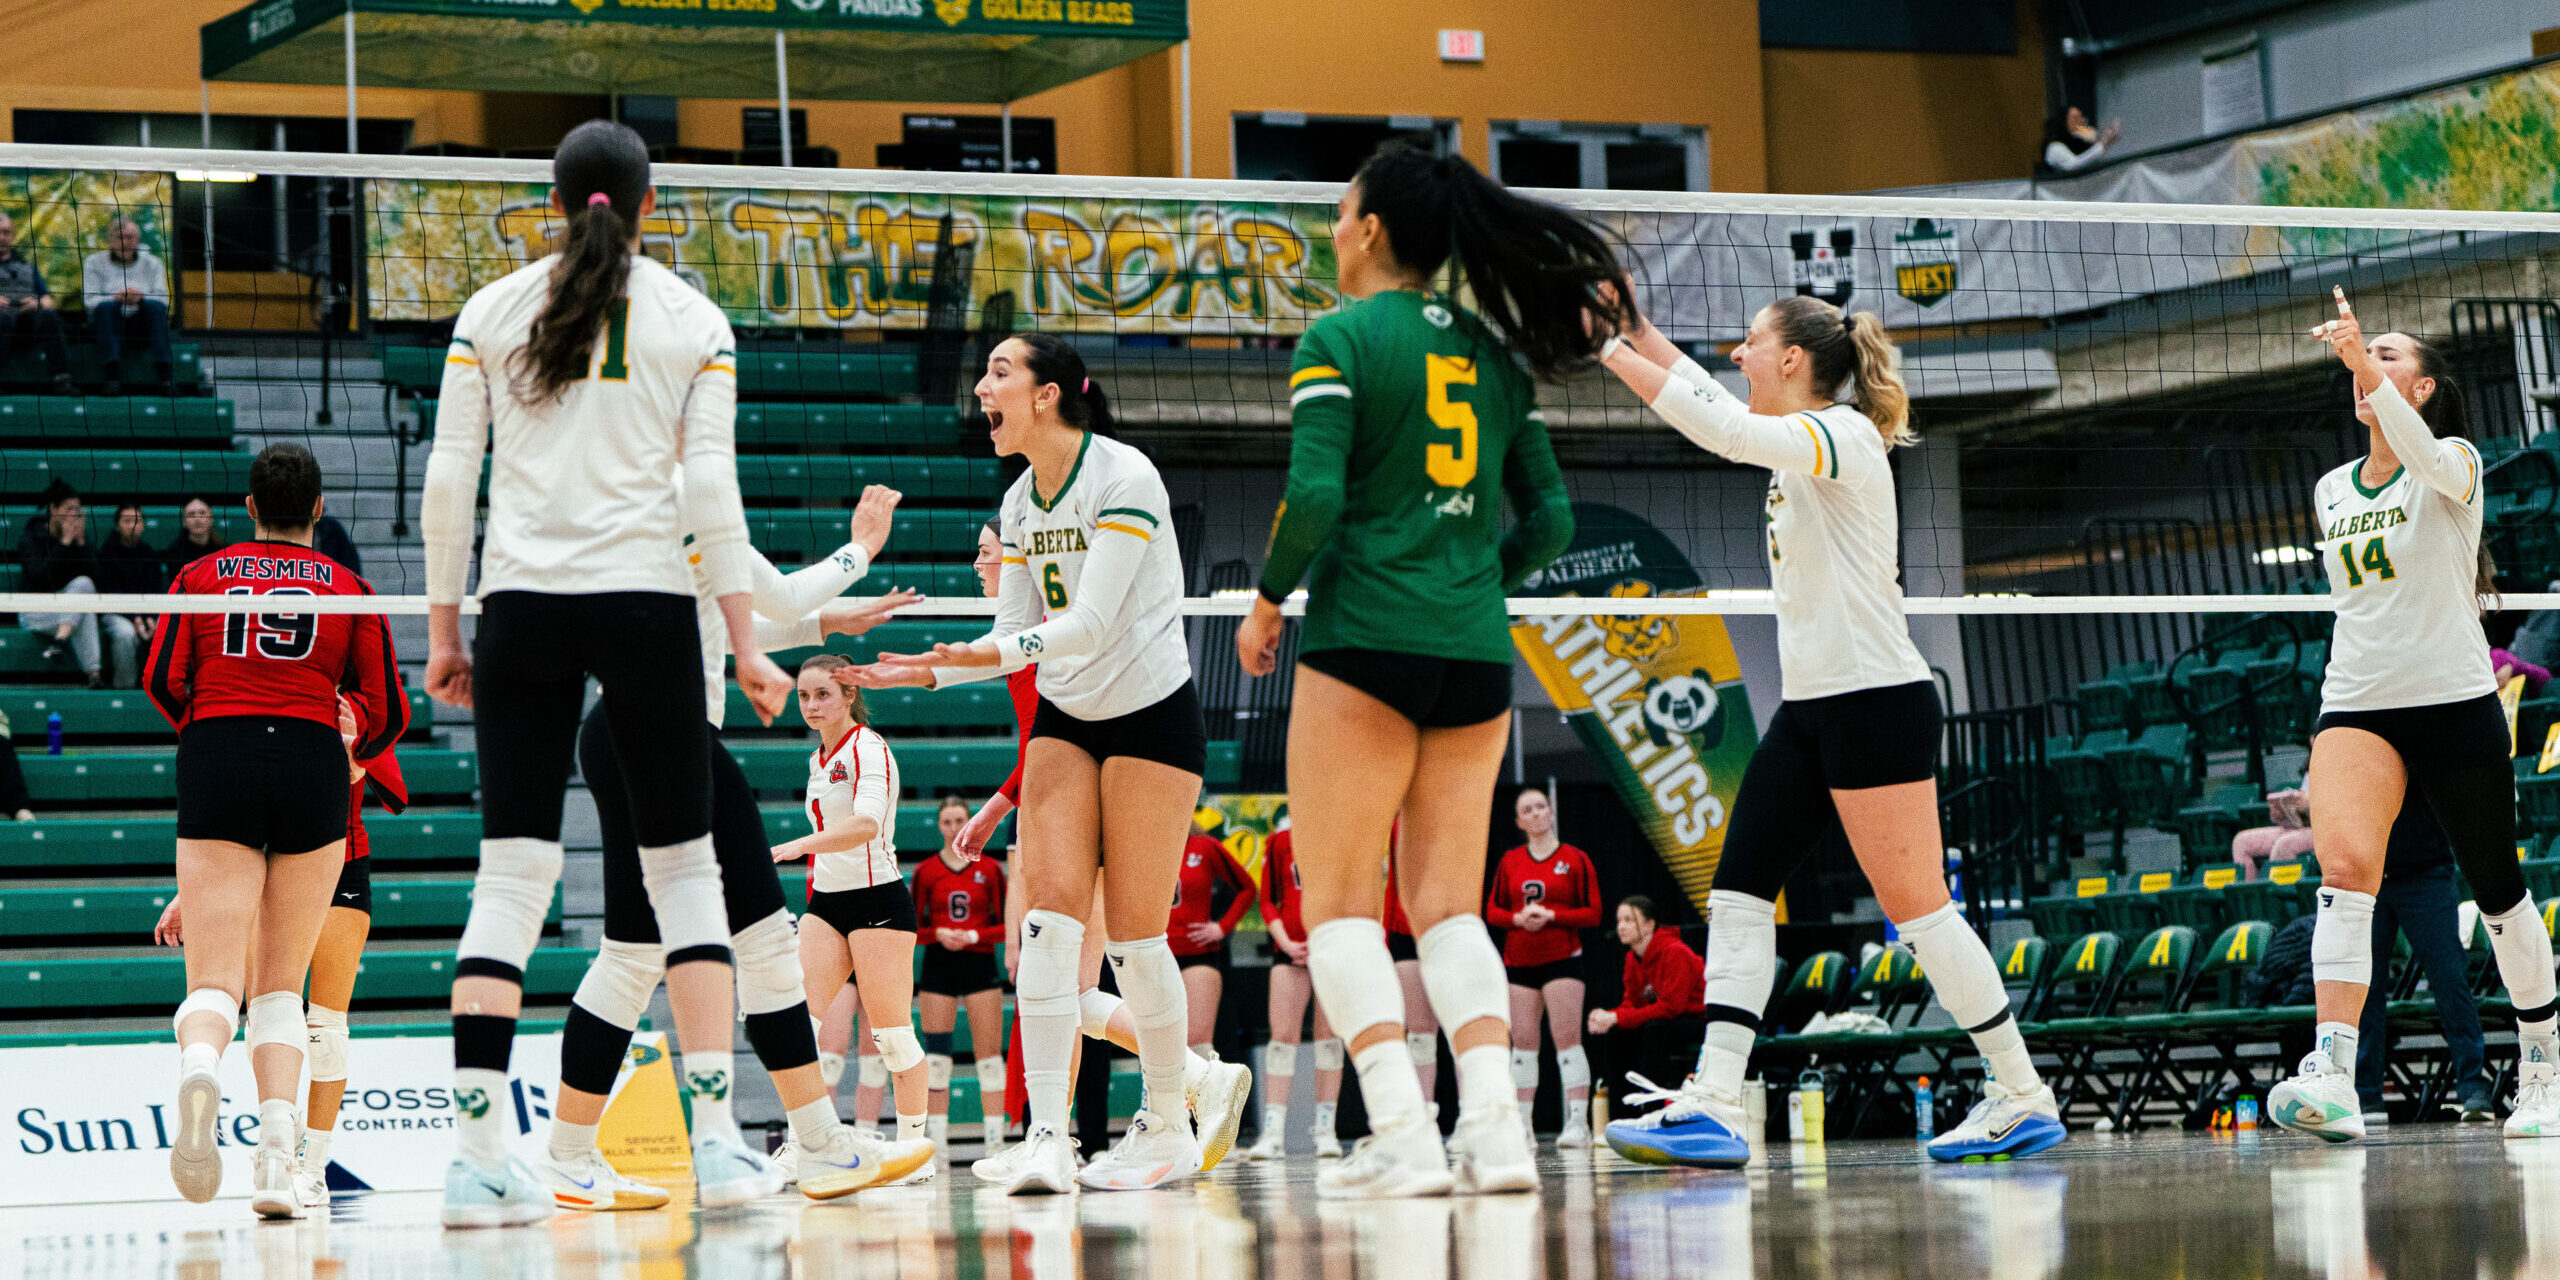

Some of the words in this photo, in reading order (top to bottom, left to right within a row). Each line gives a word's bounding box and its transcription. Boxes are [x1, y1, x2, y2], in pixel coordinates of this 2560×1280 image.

[981, 0, 1063, 21] GOLDEN
[1067, 1, 1135, 25] BEARS
[1021, 206, 1339, 318] ROAR
[1898, 265, 1954, 296] WEST
[1426, 353, 1478, 488] 5
[2327, 506, 2408, 541] ALBERTA
[1025, 527, 1089, 557] BERTA
[216, 556, 332, 586] WESMEN
[1545, 552, 1642, 585] ALBERTA
[2339, 535, 2397, 588] 14
[1042, 561, 1069, 611] 6
[222, 586, 319, 661] 19
[949, 891, 971, 922] 6
[16, 1107, 141, 1155] Sun
